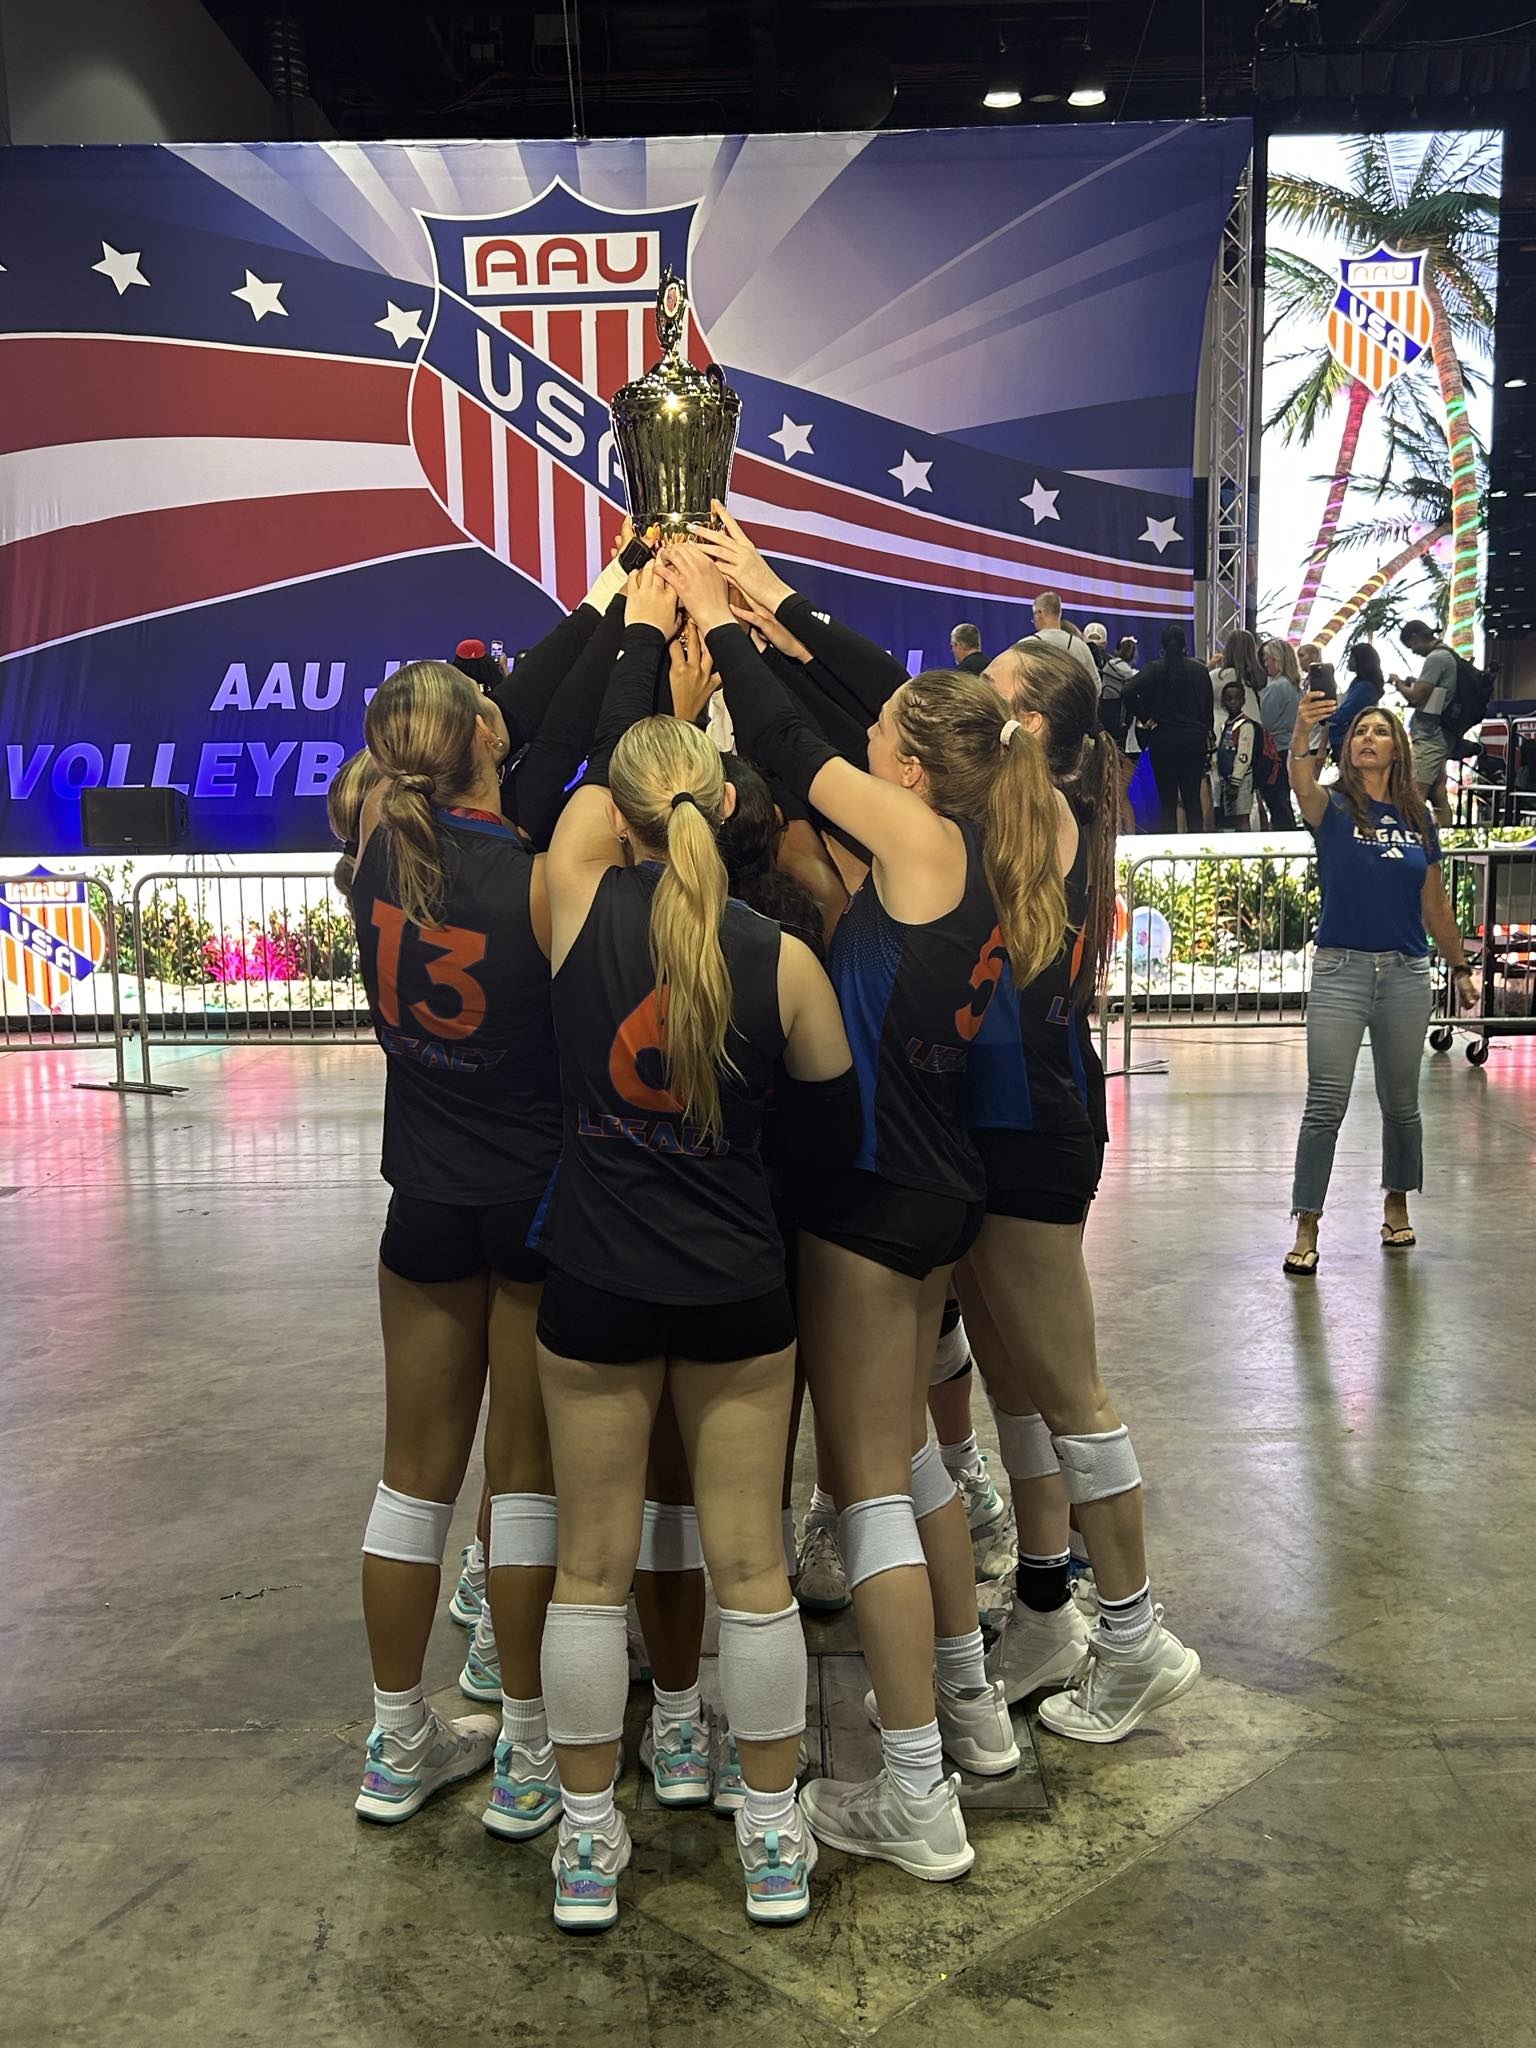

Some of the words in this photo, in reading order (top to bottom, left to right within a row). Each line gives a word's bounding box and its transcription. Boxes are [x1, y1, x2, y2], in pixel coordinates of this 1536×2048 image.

[475, 236, 649, 287] AAU
[1349, 295, 1406, 361] USA
[210, 662, 346, 711] AAU
[6, 741, 346, 800] VOLLEYB
[9, 911, 77, 977] USA
[371, 897, 488, 1040] 13
